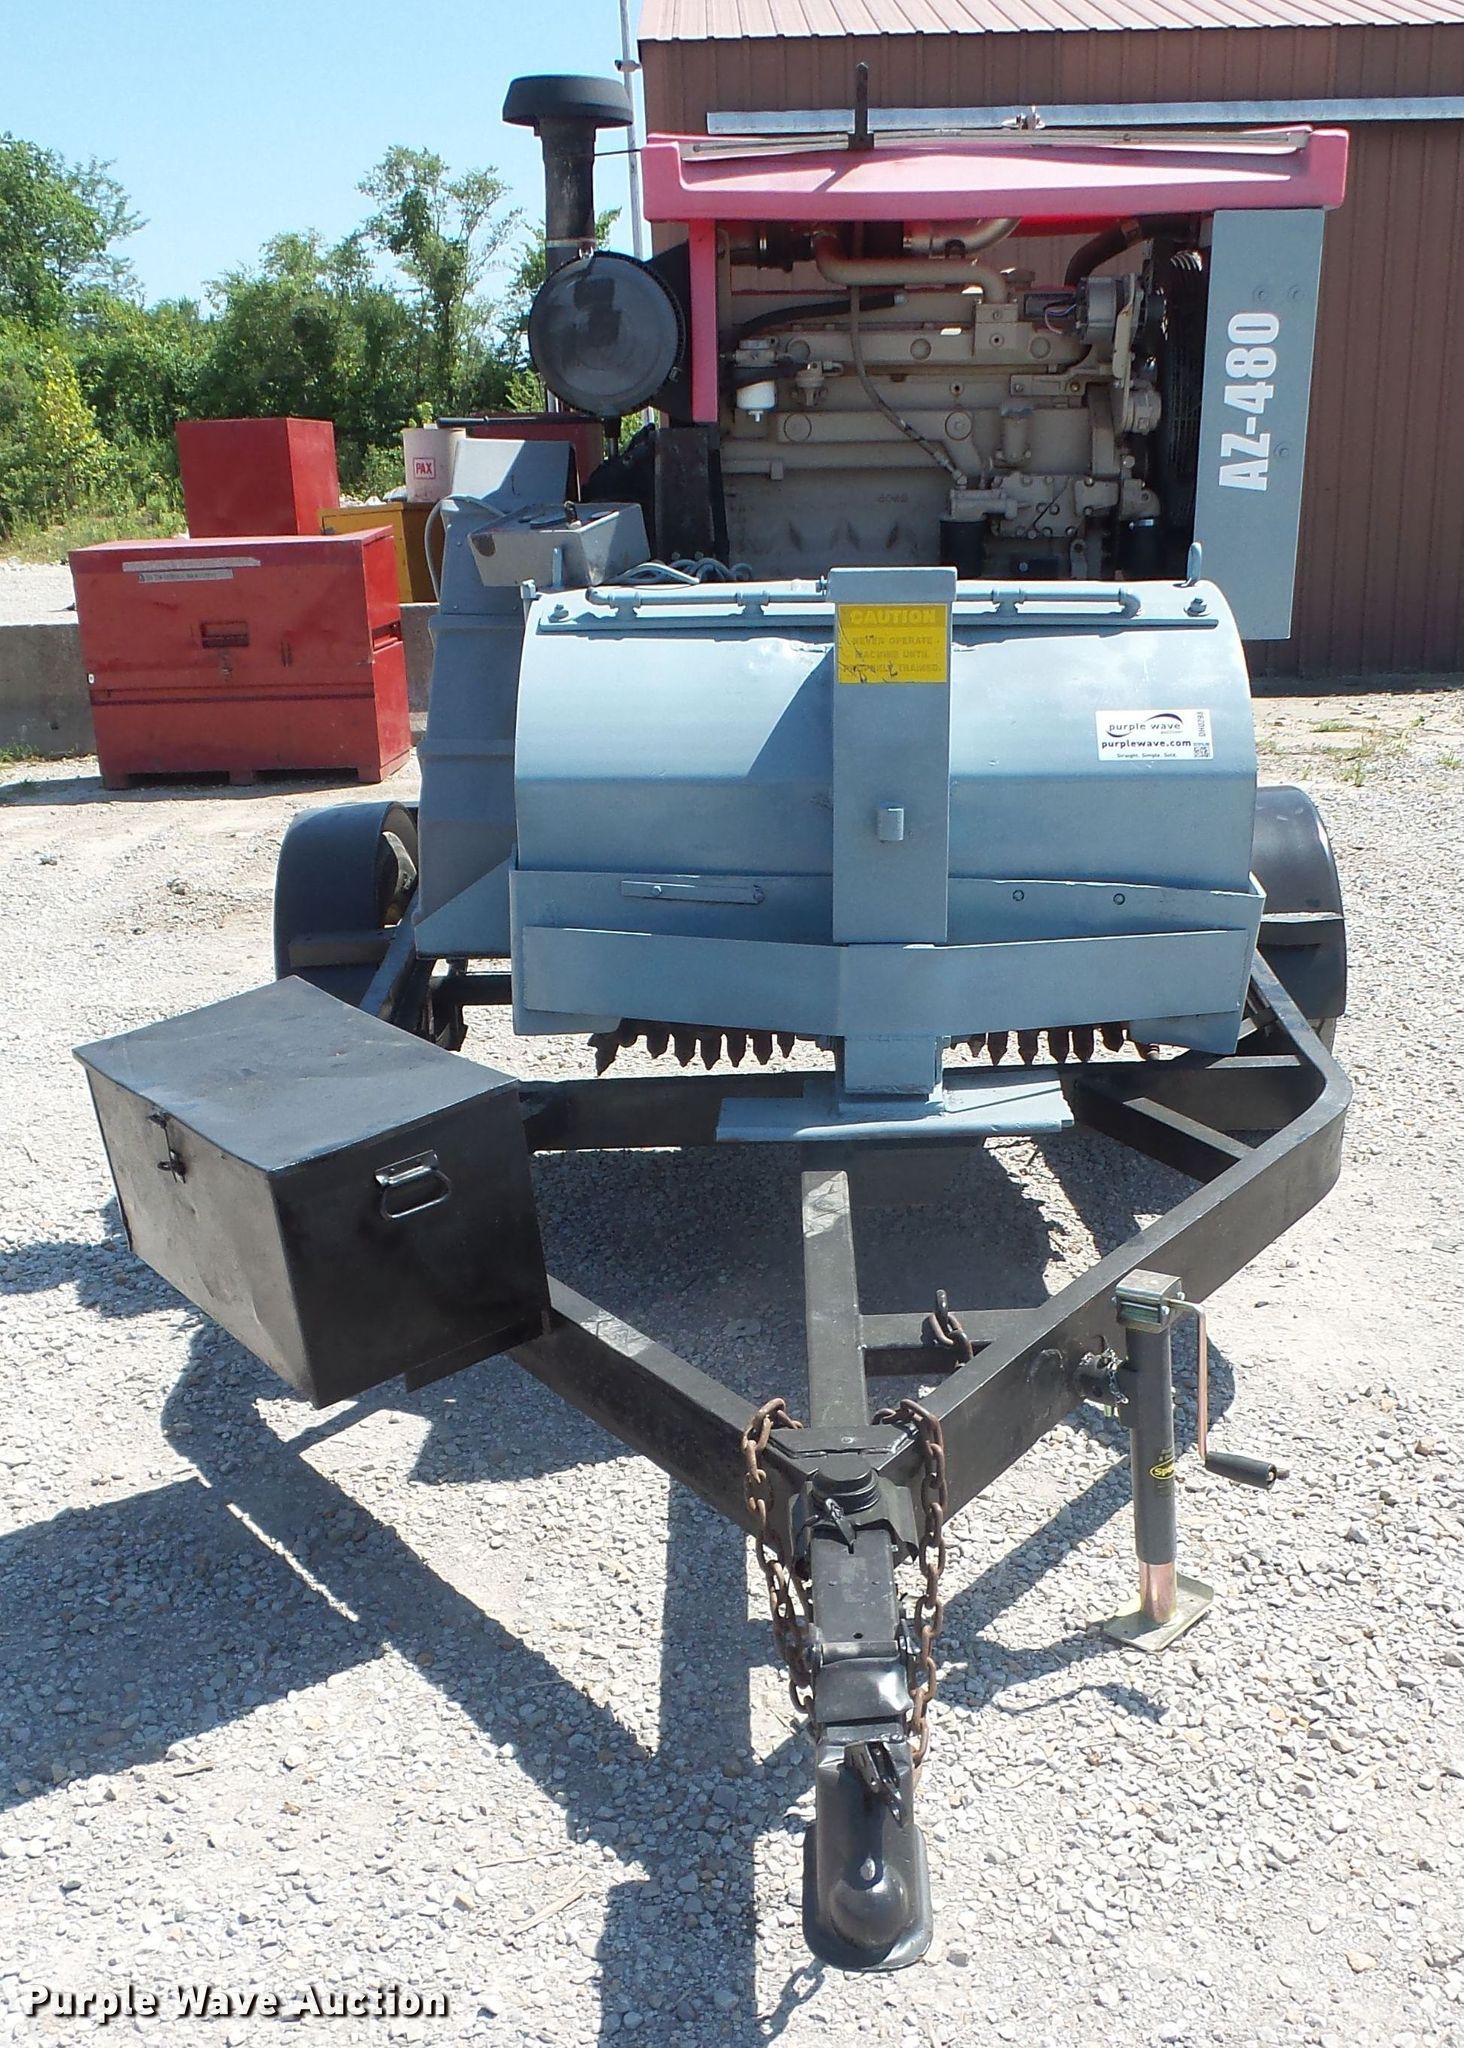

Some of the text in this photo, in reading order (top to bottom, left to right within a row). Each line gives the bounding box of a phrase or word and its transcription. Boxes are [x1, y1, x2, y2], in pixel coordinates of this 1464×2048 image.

[1218, 312, 1280, 492] AZ-480
[415, 462, 433, 475] PAX
[850, 609, 937, 625] CAUTION
[888, 636, 934, 646] OPERATE
[902, 650, 928, 659] UNTIL
[1108, 722, 1181, 732] purple wave
[1101, 739, 1192, 749] purplewave.com
